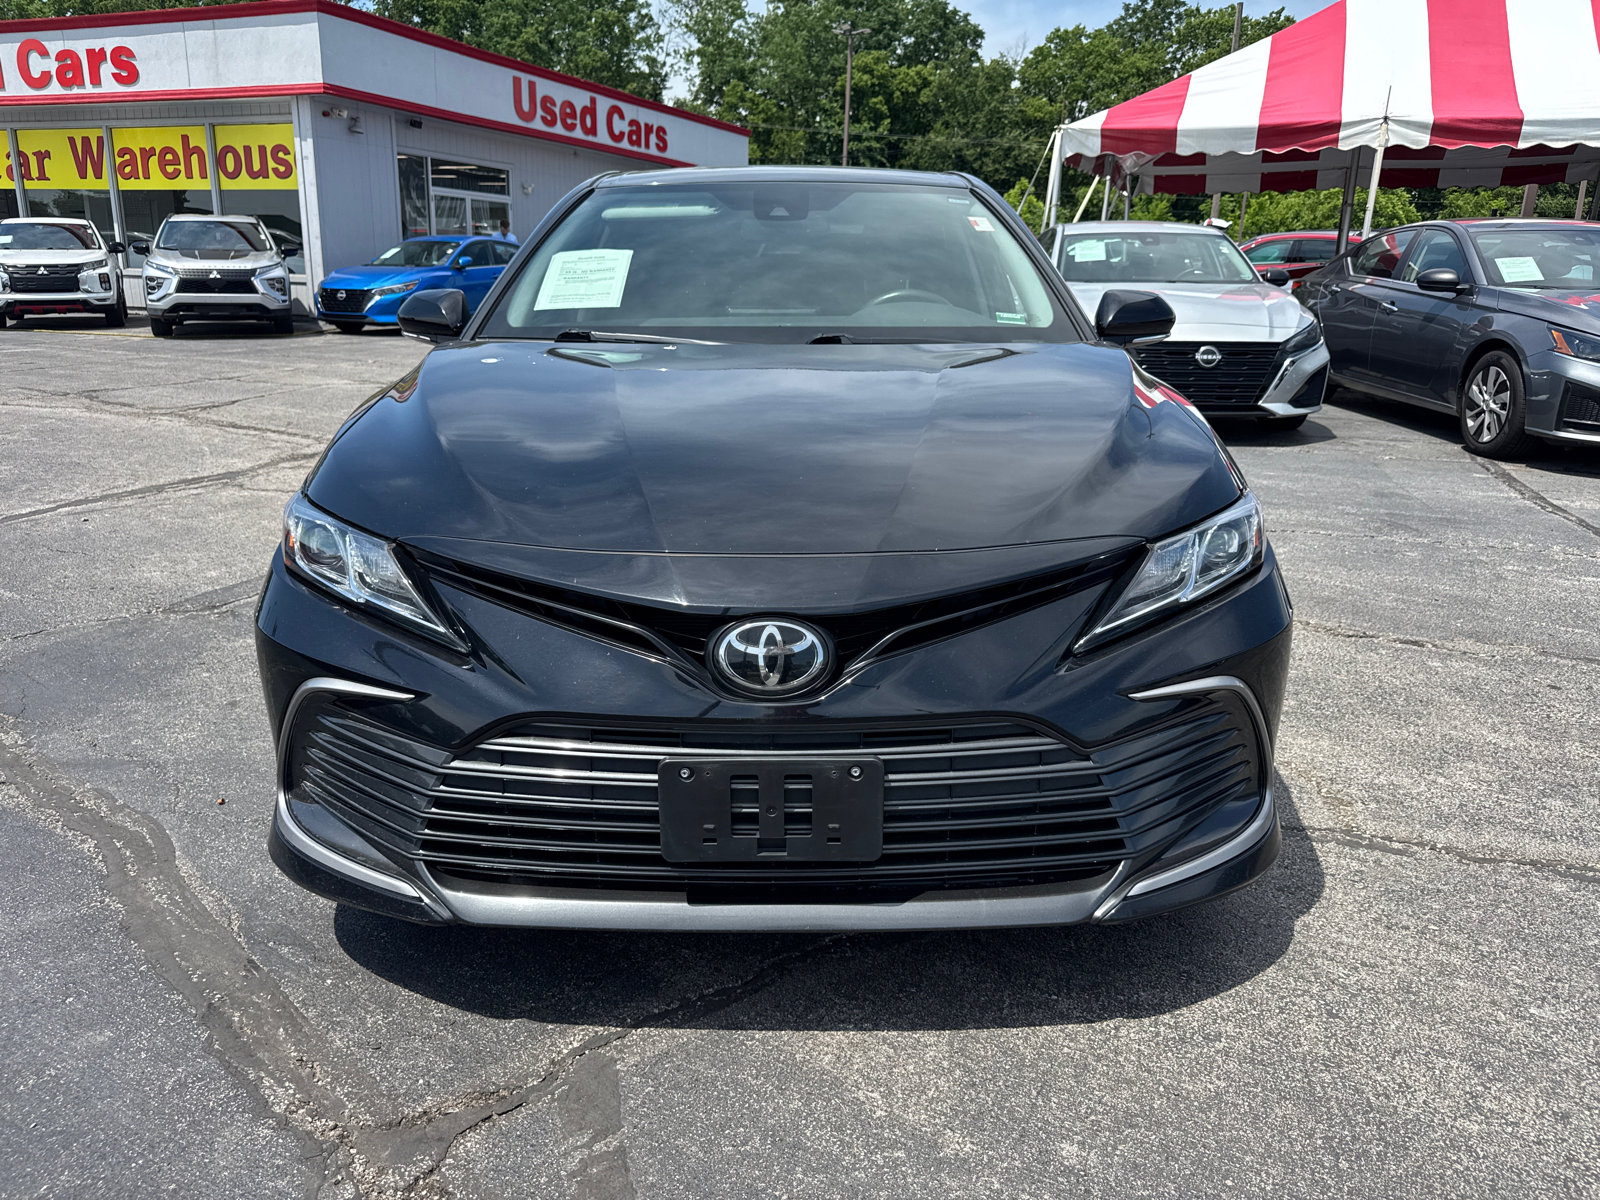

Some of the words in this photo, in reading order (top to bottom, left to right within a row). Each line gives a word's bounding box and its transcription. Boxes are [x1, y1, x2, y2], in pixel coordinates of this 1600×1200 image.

[17, 38, 139, 89] Cars
[512, 75, 598, 138] Used
[606, 104, 669, 154] Cars
[0, 149, 51, 182] ar
[67, 135, 297, 181] Warehous
